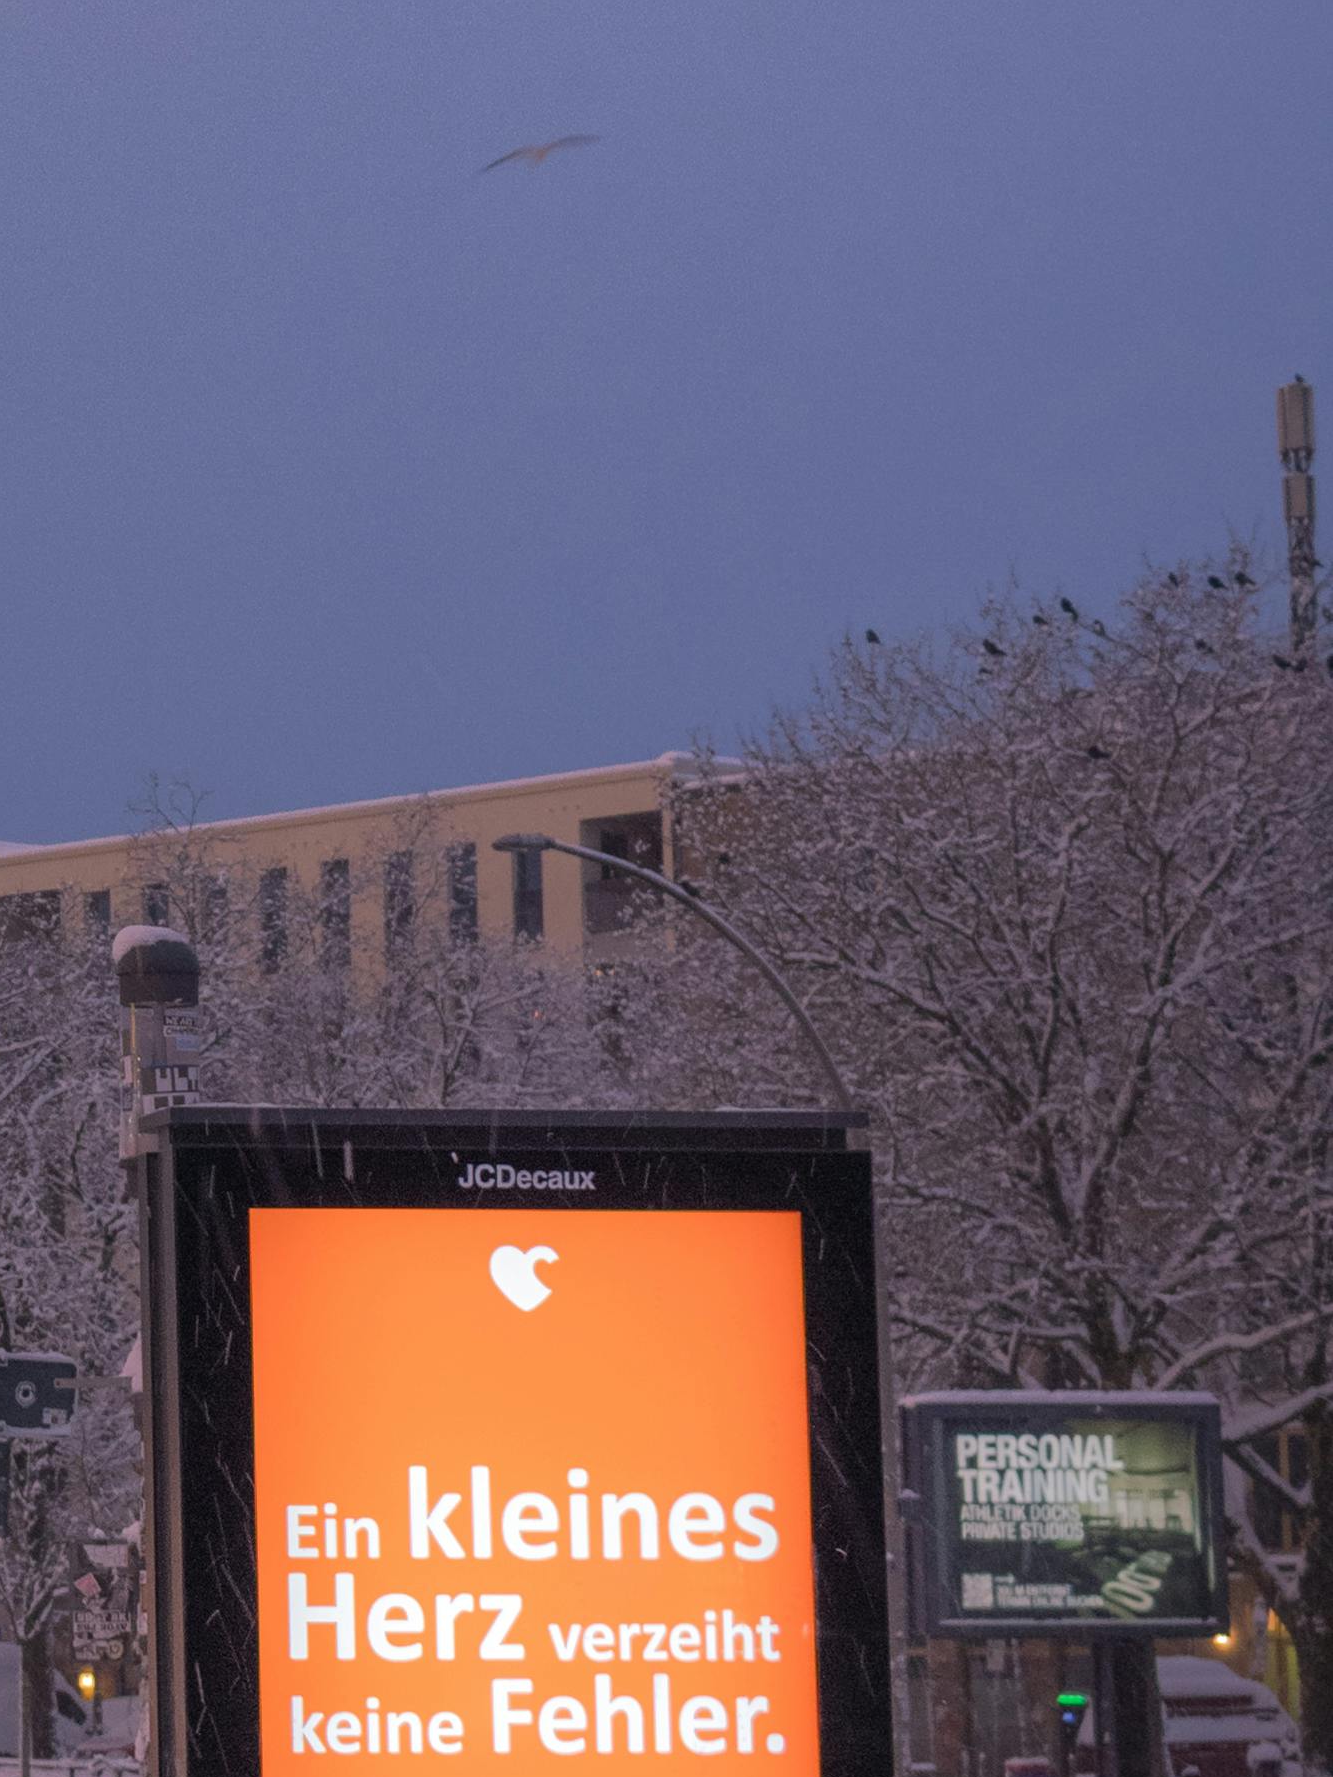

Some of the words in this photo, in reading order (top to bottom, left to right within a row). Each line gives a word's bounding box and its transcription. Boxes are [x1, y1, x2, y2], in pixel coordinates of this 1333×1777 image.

[457, 1163, 597, 1191] JCDecaux
[956, 1434, 1124, 1469] PERSONAL
[958, 1469, 1109, 1504] TRAINING
[286, 1503, 380, 1559] Ein
[408, 1465, 779, 1561] kleines
[961, 1504, 1026, 1521] ATHLETIK
[1031, 1504, 1081, 1522] DOCKS
[962, 1521, 1016, 1540] PRIVATE
[1021, 1521, 1084, 1540] STUDIOS
[287, 1572, 526, 1661] Herz
[548, 1610, 781, 1662] verzeiht
[290, 1695, 464, 1754] keine
[491, 1673, 786, 1754] Fehler.
